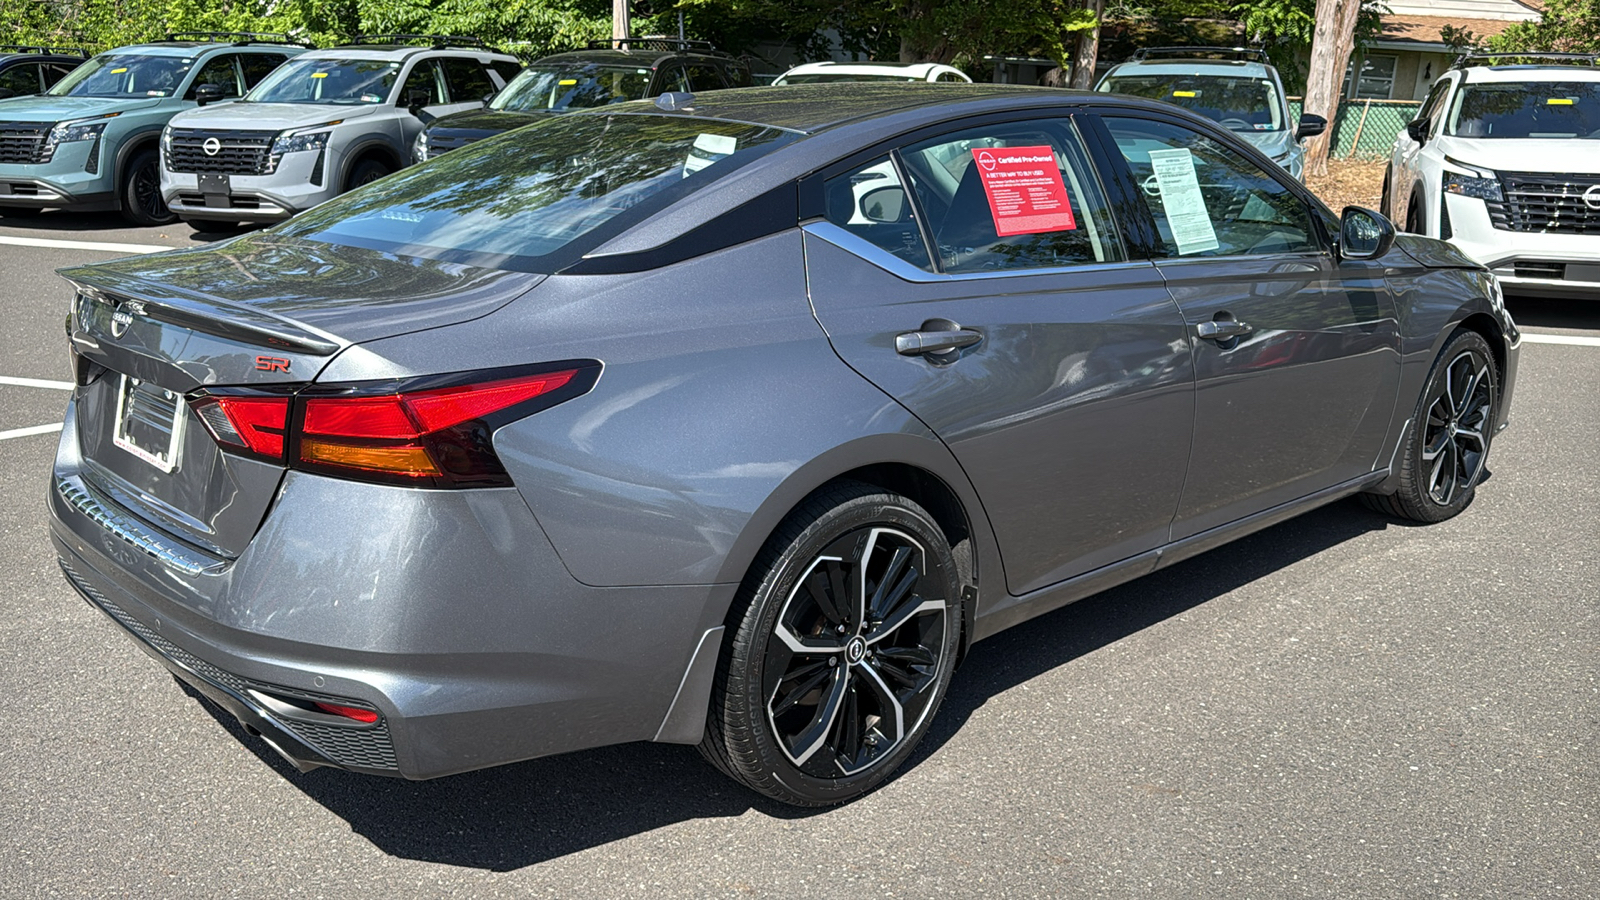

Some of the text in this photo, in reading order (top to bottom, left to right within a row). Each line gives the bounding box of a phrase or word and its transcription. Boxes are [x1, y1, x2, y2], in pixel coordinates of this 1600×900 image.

[998, 155, 1053, 164] Certified Pre-Owned
[113, 311, 134, 325] ISSAN
[255, 356, 291, 374] SR
